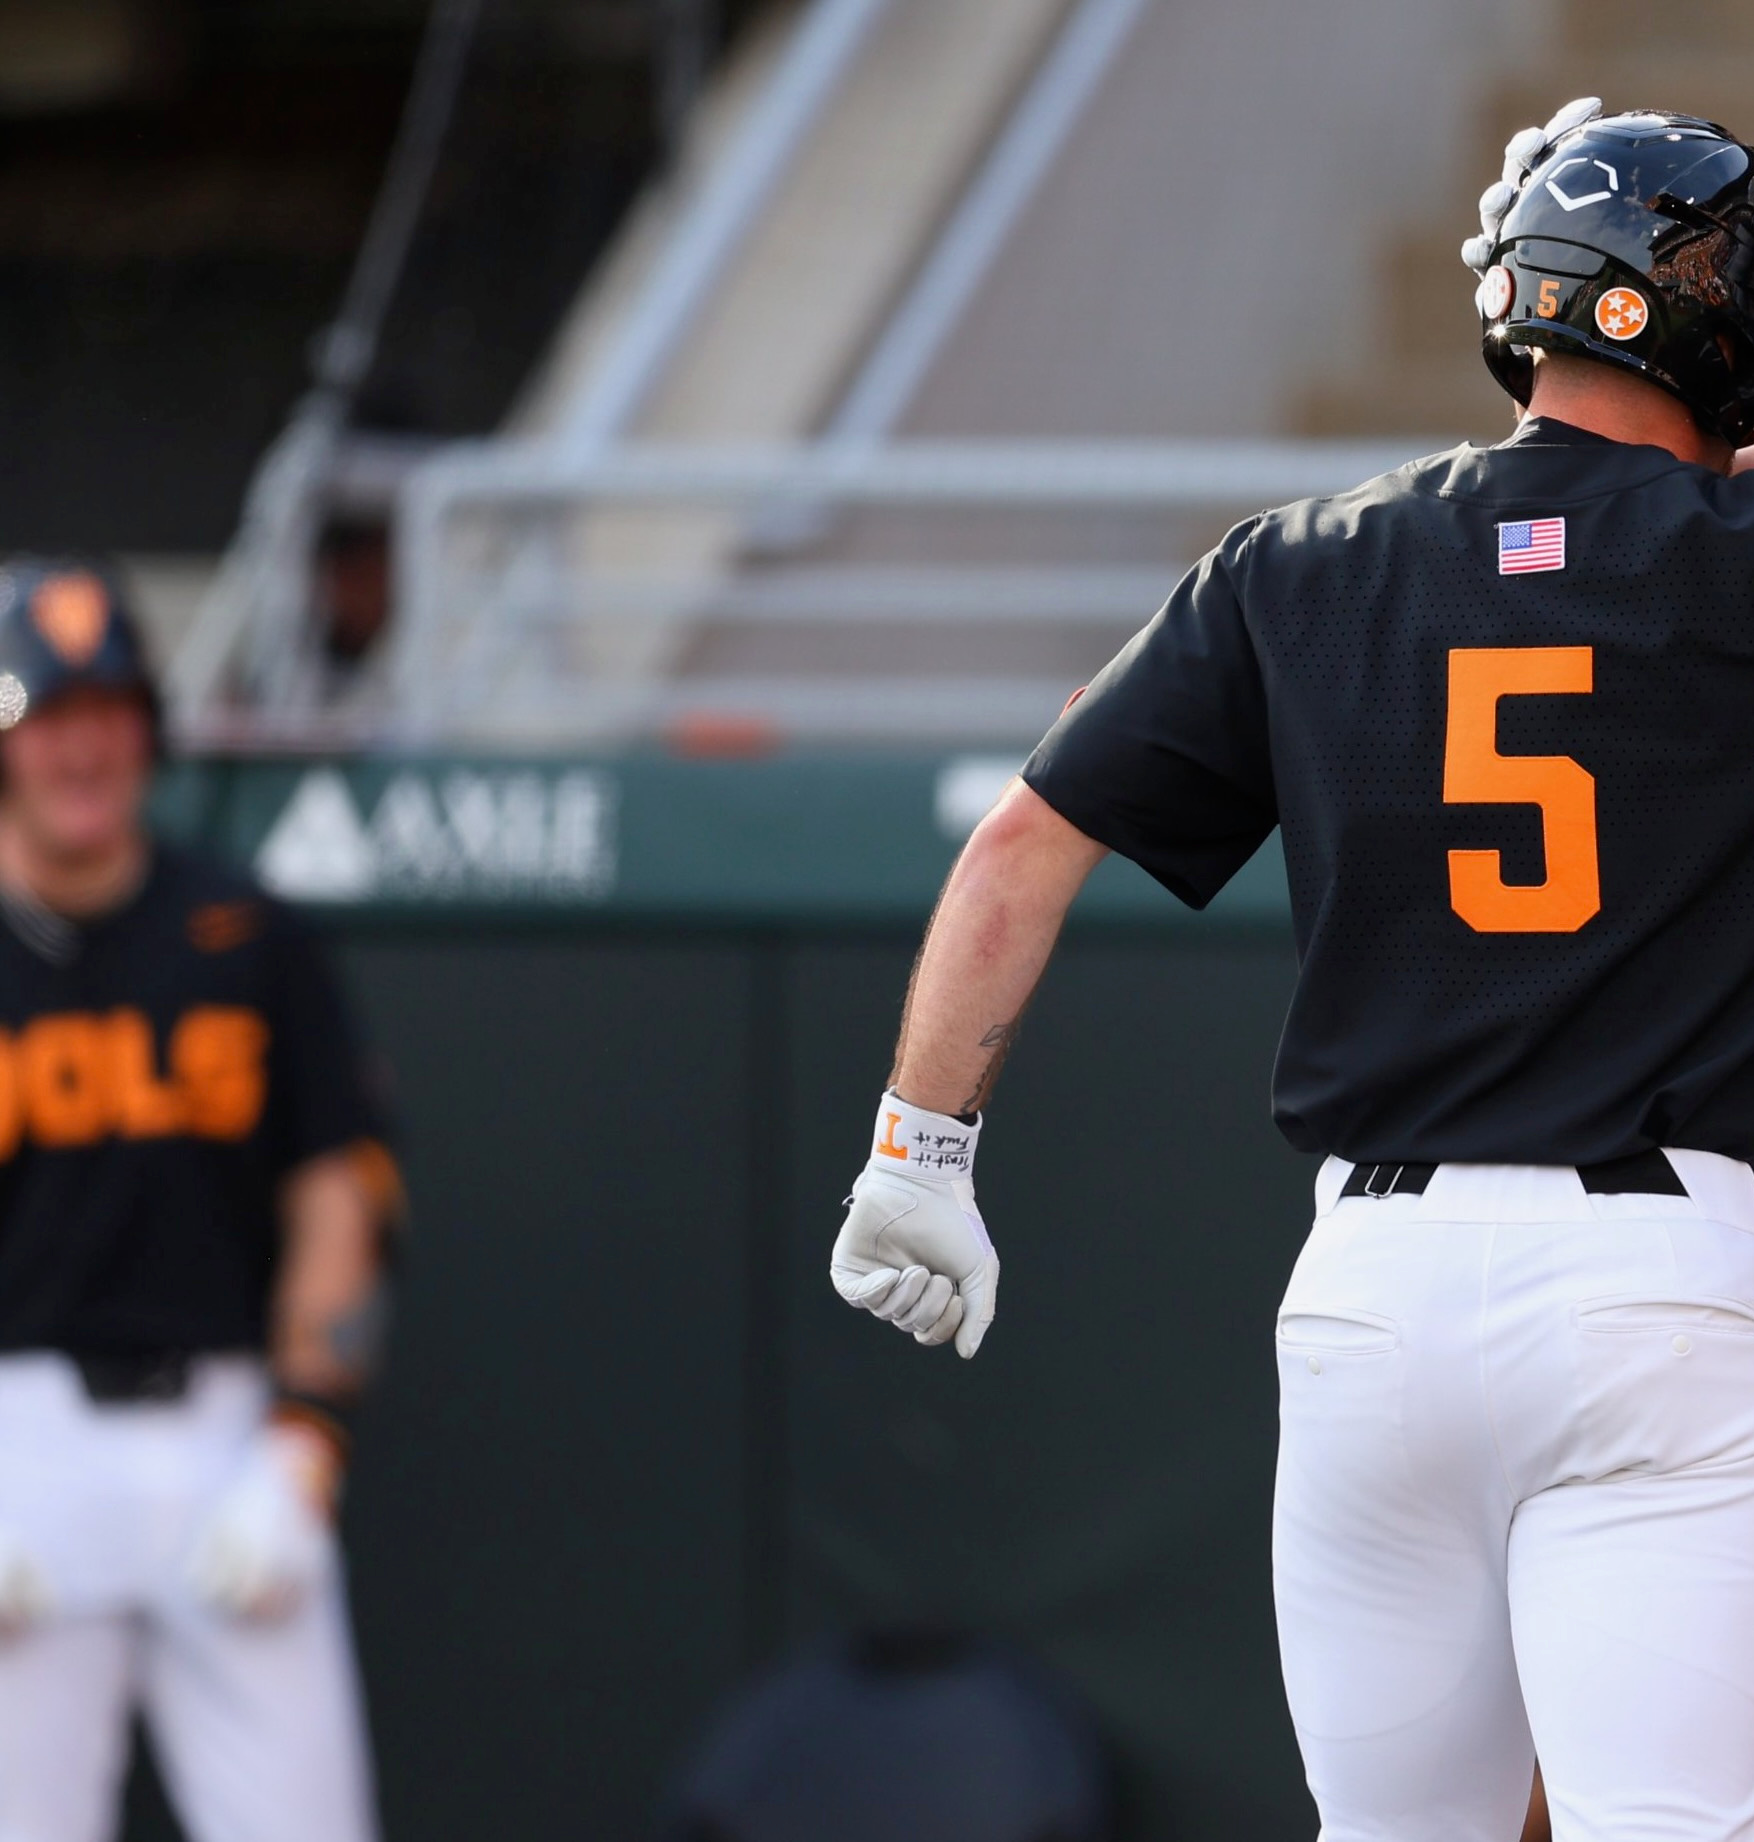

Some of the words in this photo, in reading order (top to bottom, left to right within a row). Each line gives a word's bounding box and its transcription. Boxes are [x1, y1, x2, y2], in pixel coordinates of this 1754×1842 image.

[1537, 280, 1560, 318] 5
[1443, 646, 1600, 932] 5
[0, 1005, 269, 1165] OLS
[877, 1113, 908, 1160] T
[912, 1131, 930, 1146] it
[935, 1135, 970, 1151] Fuck
[911, 1152, 931, 1168] it
[932, 1155, 969, 1172] Trust
